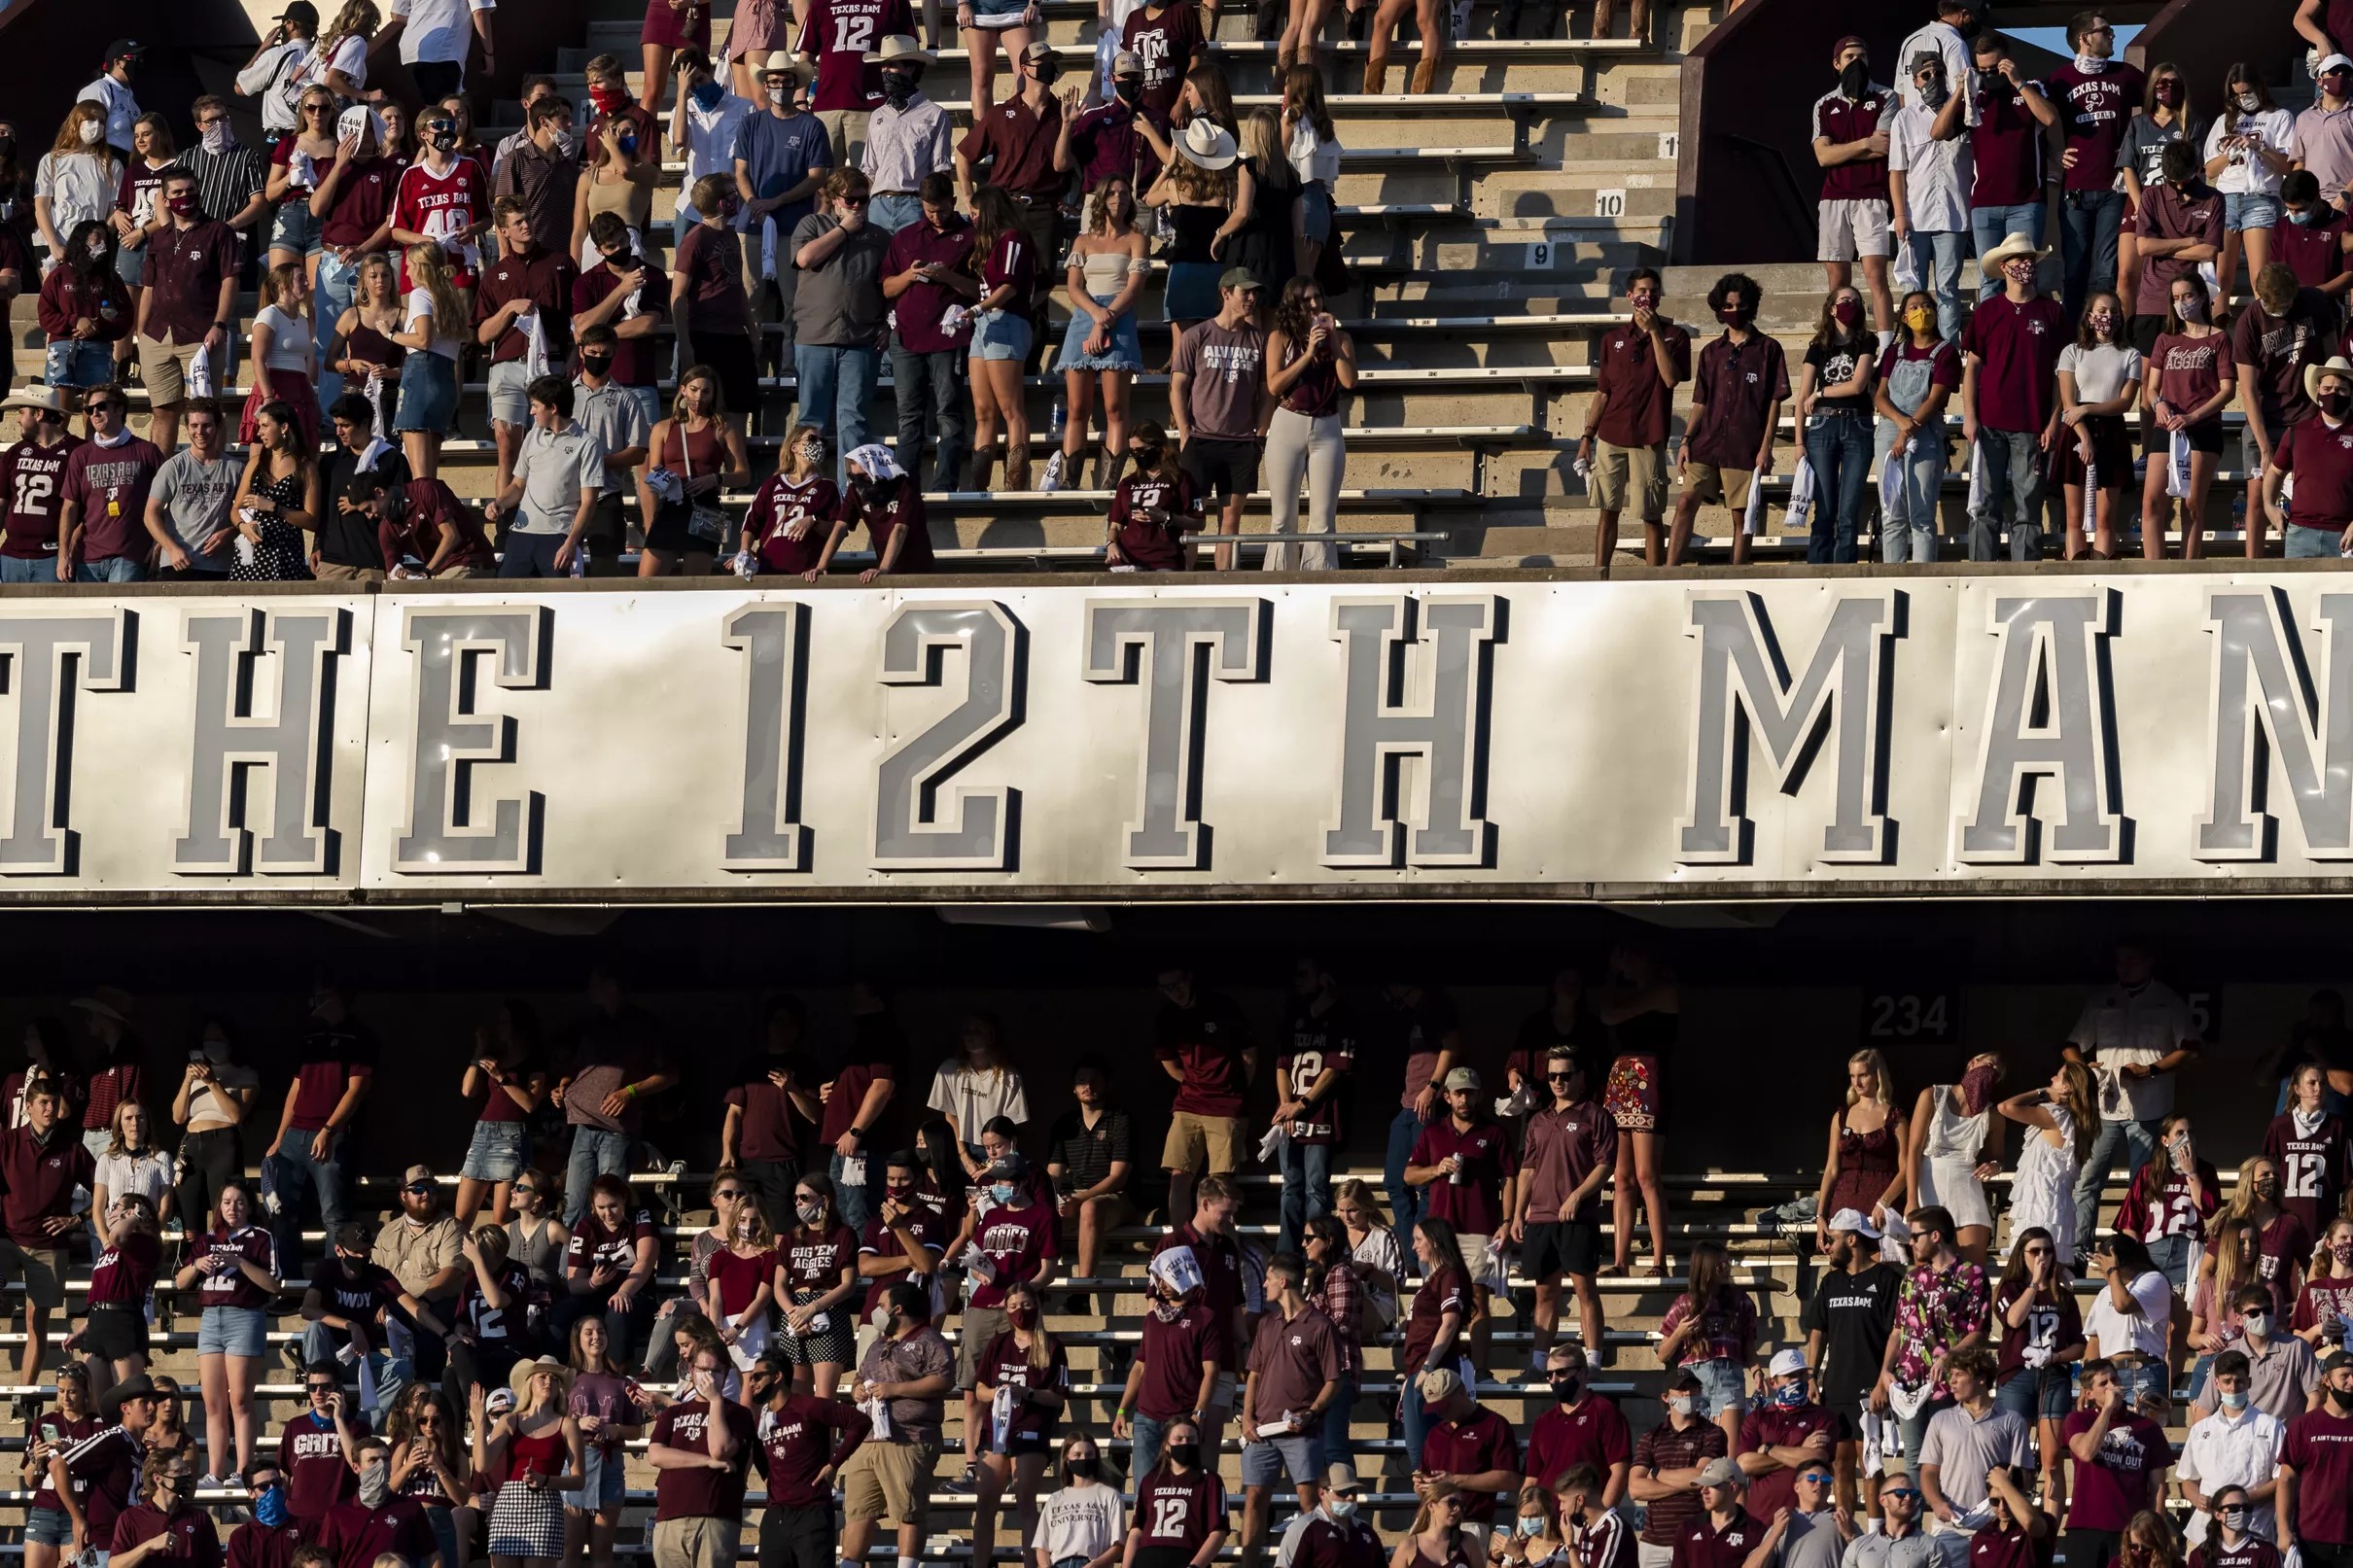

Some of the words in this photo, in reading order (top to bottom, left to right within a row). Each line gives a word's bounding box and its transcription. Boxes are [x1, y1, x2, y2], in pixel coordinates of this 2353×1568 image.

[830, 5, 860, 15] TEXAS
[862, 5, 881, 14] A&M
[832, 17, 873, 52] 12
[2067, 82, 2098, 102] TEXAS
[2101, 80, 2121, 95] A&M
[418, 195, 450, 209] TEXAS
[1598, 196, 1622, 216] 10
[1534, 244, 1548, 264] 9
[1204, 345, 1259, 362] ALWAYS
[1207, 357, 1221, 368] AN
[18, 458, 43, 471] TEXAS
[45, 459, 60, 472] A&M
[86, 463, 115, 482] TEXAS
[117, 461, 141, 477] A&M
[92, 476, 134, 488] AGGIES
[181, 484, 209, 495] TEXAS
[14, 474, 53, 515] 12
[773, 493, 796, 504] TEXAS
[772, 505, 804, 538] 12
[0, 605, 553, 875] THE
[720, 596, 1510, 871] 12TH
[1674, 587, 2353, 865] MAN
[1870, 994, 1948, 1036] 234
[1291, 1051, 1323, 1096] 12
[2287, 1142, 2309, 1151] TEXAS
[2285, 1154, 2326, 1198] 12
[917, 1193, 933, 1202] TEXAS
[2145, 1196, 2199, 1242] 12
[569, 1236, 584, 1254] 12
[598, 1243, 615, 1252] TEXAS
[791, 1247, 813, 1258] GIG
[793, 1257, 831, 1269] AGGIES
[1829, 1298, 1853, 1307] TEXAS
[1854, 1297, 1872, 1307] A&M
[2028, 1313, 2059, 1348] 12
[673, 1413, 702, 1432] TEXAS
[295, 1433, 339, 1454] GRIT
[2125, 1456, 2143, 1468] OUT
[1154, 1487, 1176, 1496] TEXAS
[1052, 1502, 1081, 1514] TEXAS
[1051, 1515, 1106, 1527] UNIVERSITY
[1151, 1498, 1187, 1538] 12
